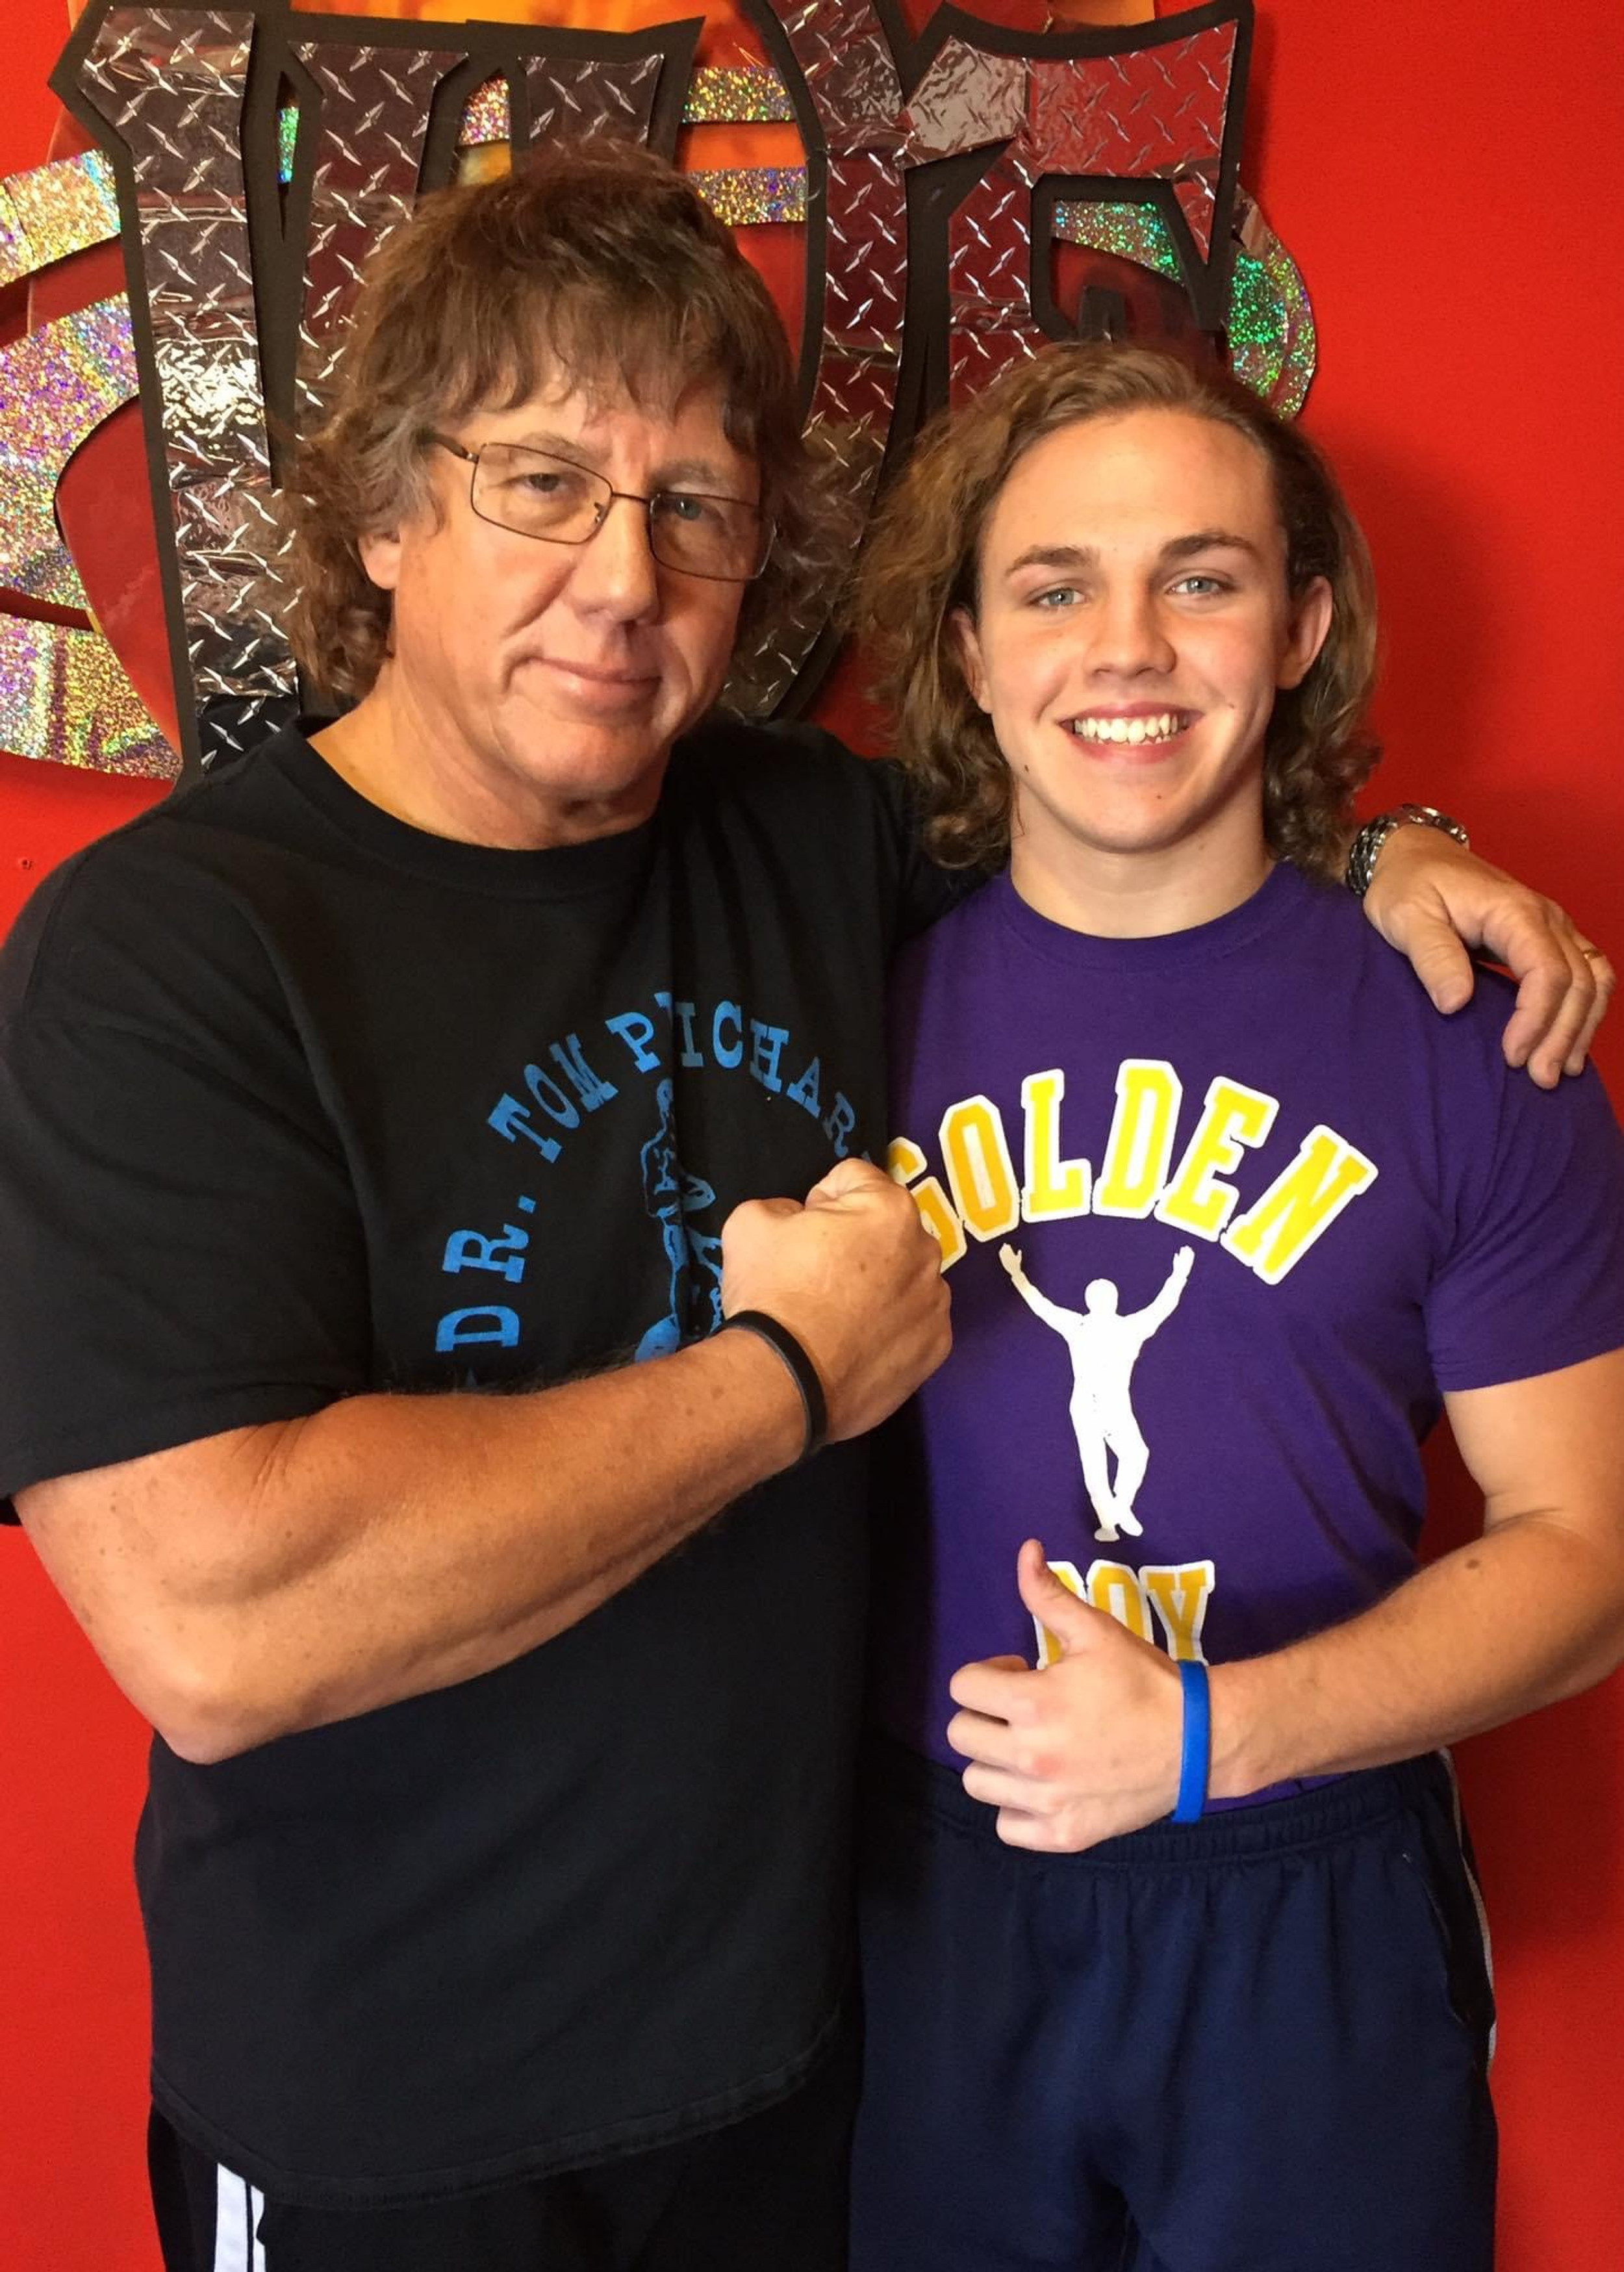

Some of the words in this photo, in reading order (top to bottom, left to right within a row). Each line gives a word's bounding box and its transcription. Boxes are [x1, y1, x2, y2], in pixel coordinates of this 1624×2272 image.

[435, 1195, 537, 1353] DR.
[486, 1033, 618, 1164] TOM
[605, 991, 872, 1164] PICHAR
